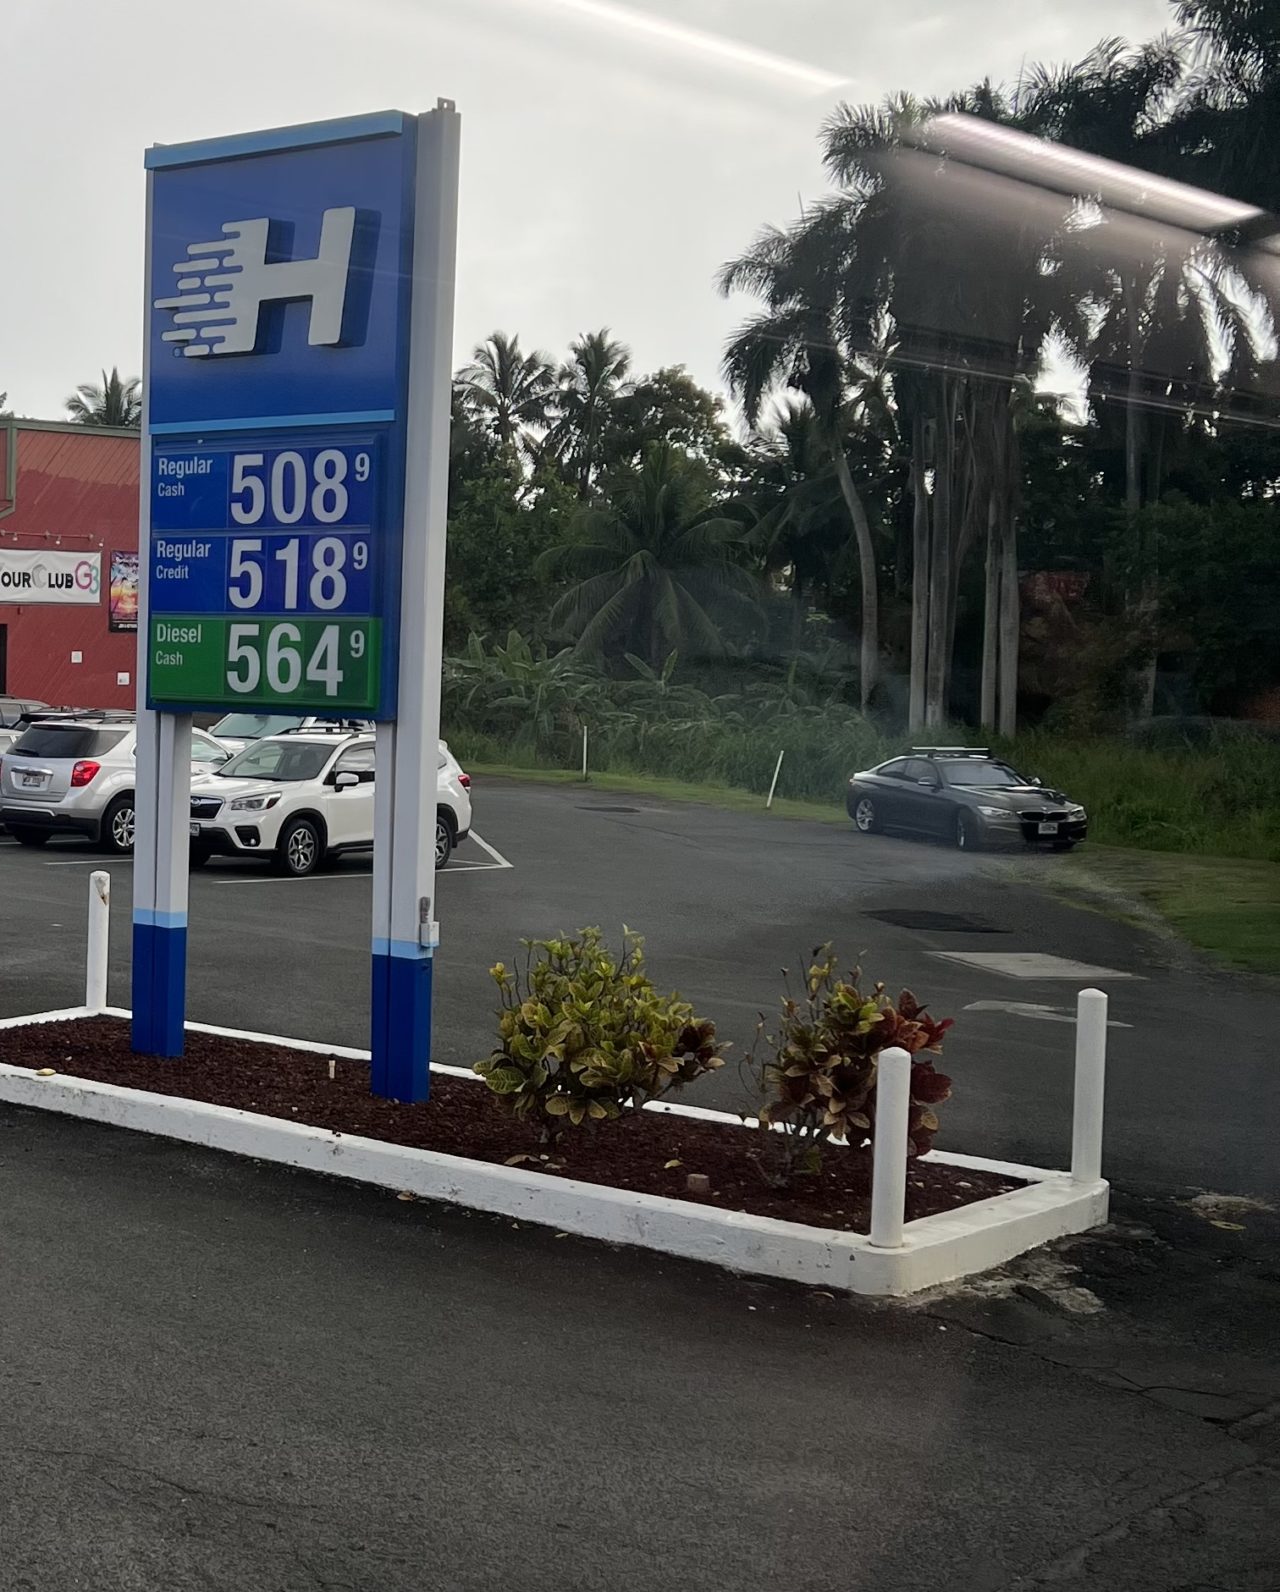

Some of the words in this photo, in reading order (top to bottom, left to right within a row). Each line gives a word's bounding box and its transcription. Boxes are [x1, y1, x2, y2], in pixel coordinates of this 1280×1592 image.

[158, 457, 213, 478] Regular
[157, 482, 185, 497] Cash
[156, 540, 211, 562] Regular
[156, 565, 189, 580] Credit
[156, 624, 202, 643] Diesel
[155, 651, 183, 665] Cash
